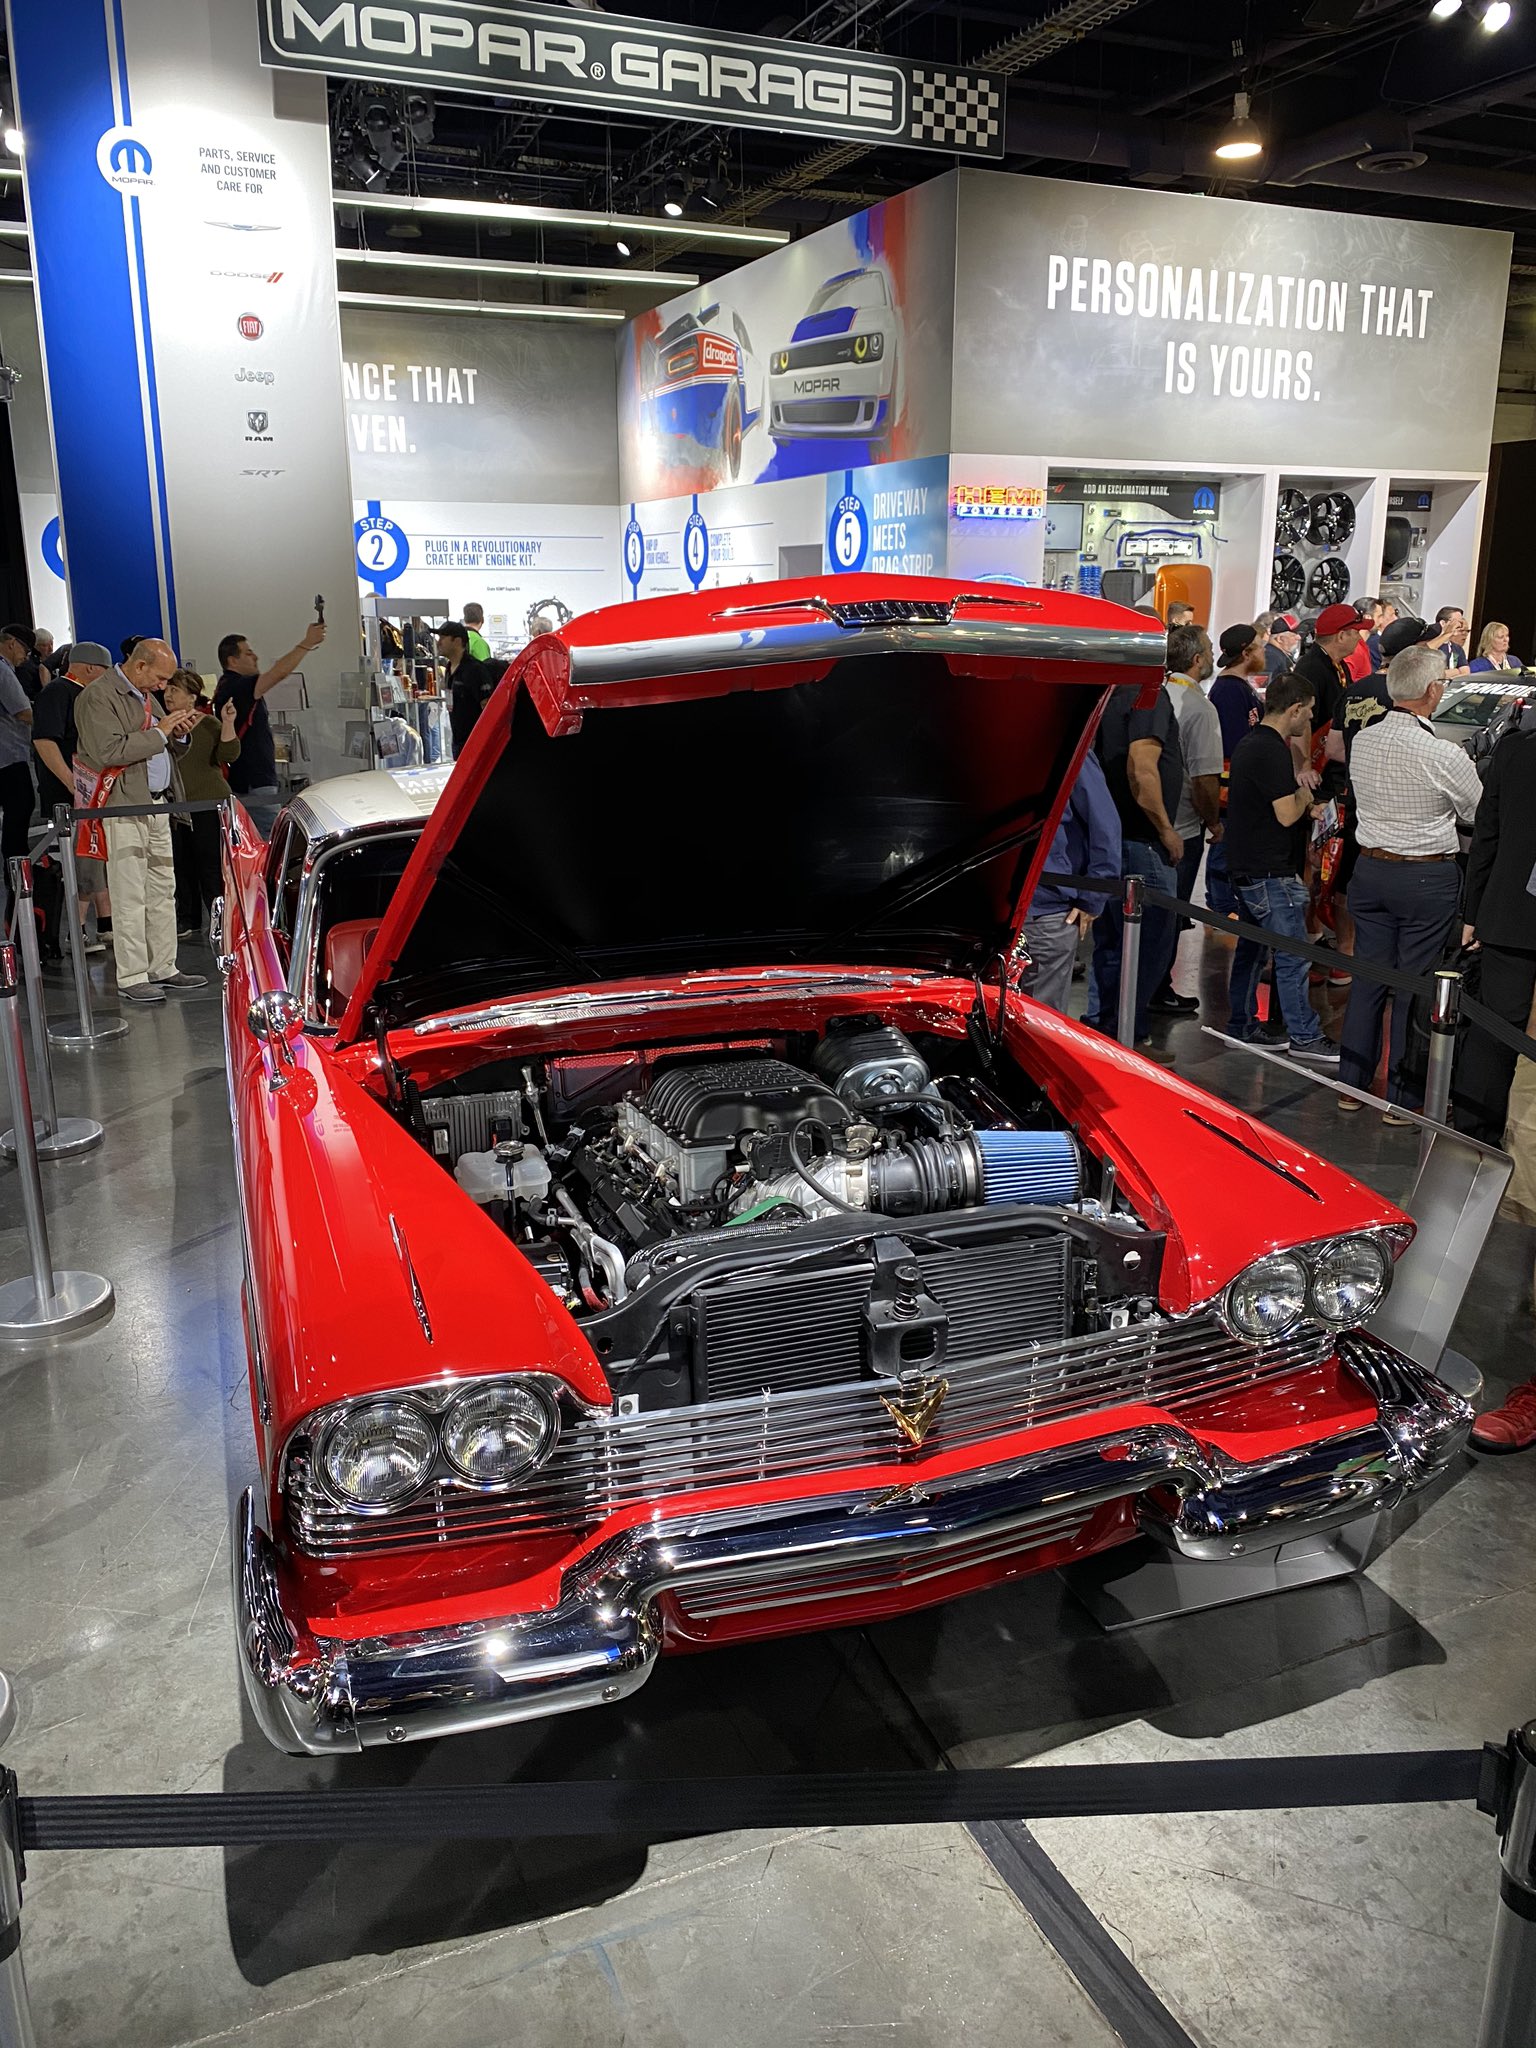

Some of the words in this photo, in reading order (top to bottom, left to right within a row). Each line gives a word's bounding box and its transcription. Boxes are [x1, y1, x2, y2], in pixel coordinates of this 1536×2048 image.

[611, 41, 894, 122] GARAGE
[199, 147, 234, 162] PARTS,
[236, 150, 276, 165] SERVICE
[201, 163, 221, 176] AND
[224, 166, 277, 181] CUSTOMER
[217, 180, 242, 193] CARE
[245, 183, 263, 195] FOR
[1047, 254, 1348, 333] PERSONALIZATION
[1360, 284, 1434, 339] THAT
[242, 320, 259, 334] FIAT
[234, 367, 275, 386] Jeep
[1164, 341, 1198, 395] IS
[1210, 344, 1321, 402] YOURS.
[406, 365, 478, 405] THAT
[793, 377, 840, 394] MOPAR
[240, 469, 286, 479] SRT
[957, 486, 1044, 506] HEMI
[1107, 484, 1150, 496] EXCLAMATION
[839, 496, 860, 515] STEP
[873, 487, 928, 521] DRIVEWAY
[360, 517, 394, 531] STEP
[688, 514, 703, 529] STEP
[844, 517, 852, 561] 5
[872, 522, 907, 552] MEETS
[370, 534, 385, 566] 2
[425, 540, 449, 553] PLUG
[450, 540, 461, 553] IN
[463, 540, 469, 553] A
[471, 540, 542, 554] REVOLUTIONARY
[631, 538, 638, 568] 3
[692, 531, 699, 566] 4
[425, 553, 455, 567] CRATE
[485, 554, 517, 567] ENGINE
[519, 554, 537, 567] KIT.
[872, 556, 899, 575] DRAG
[902, 553, 935, 577] STRIP
